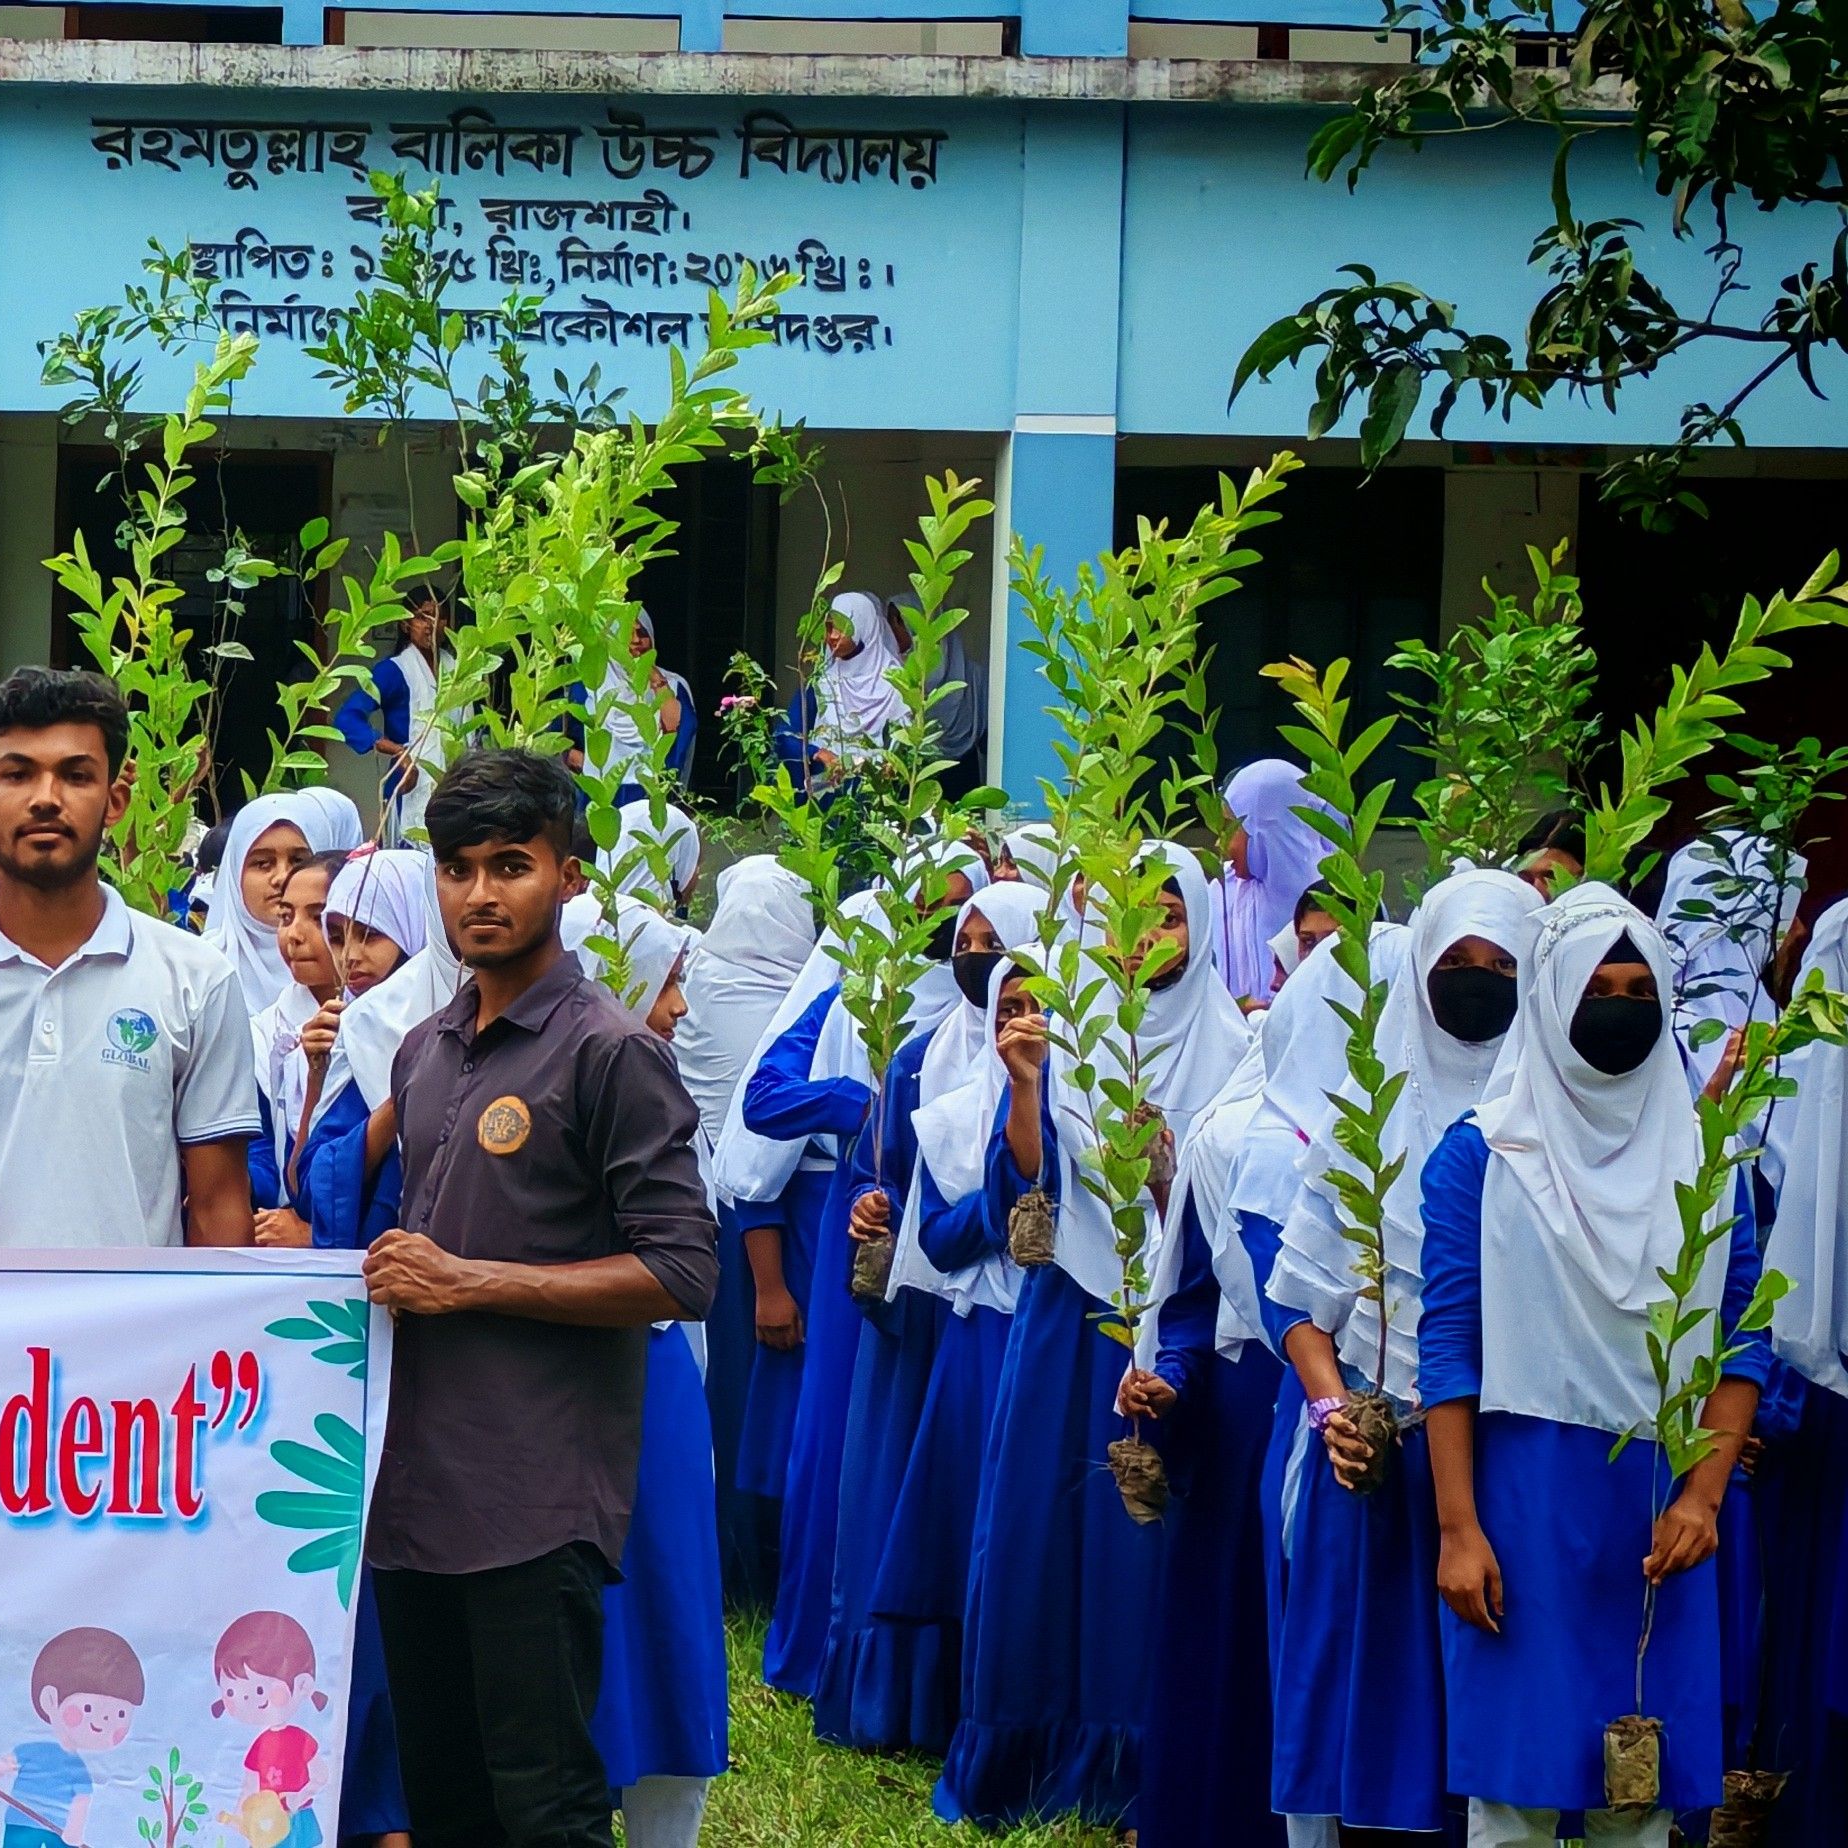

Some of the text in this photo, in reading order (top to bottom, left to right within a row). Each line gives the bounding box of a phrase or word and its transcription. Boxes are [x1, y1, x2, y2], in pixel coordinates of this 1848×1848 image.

[389, 107, 583, 177] বালিকা
[592, 107, 720, 180] উচ্চ
[734, 108, 949, 190] বিদ্যালয়
